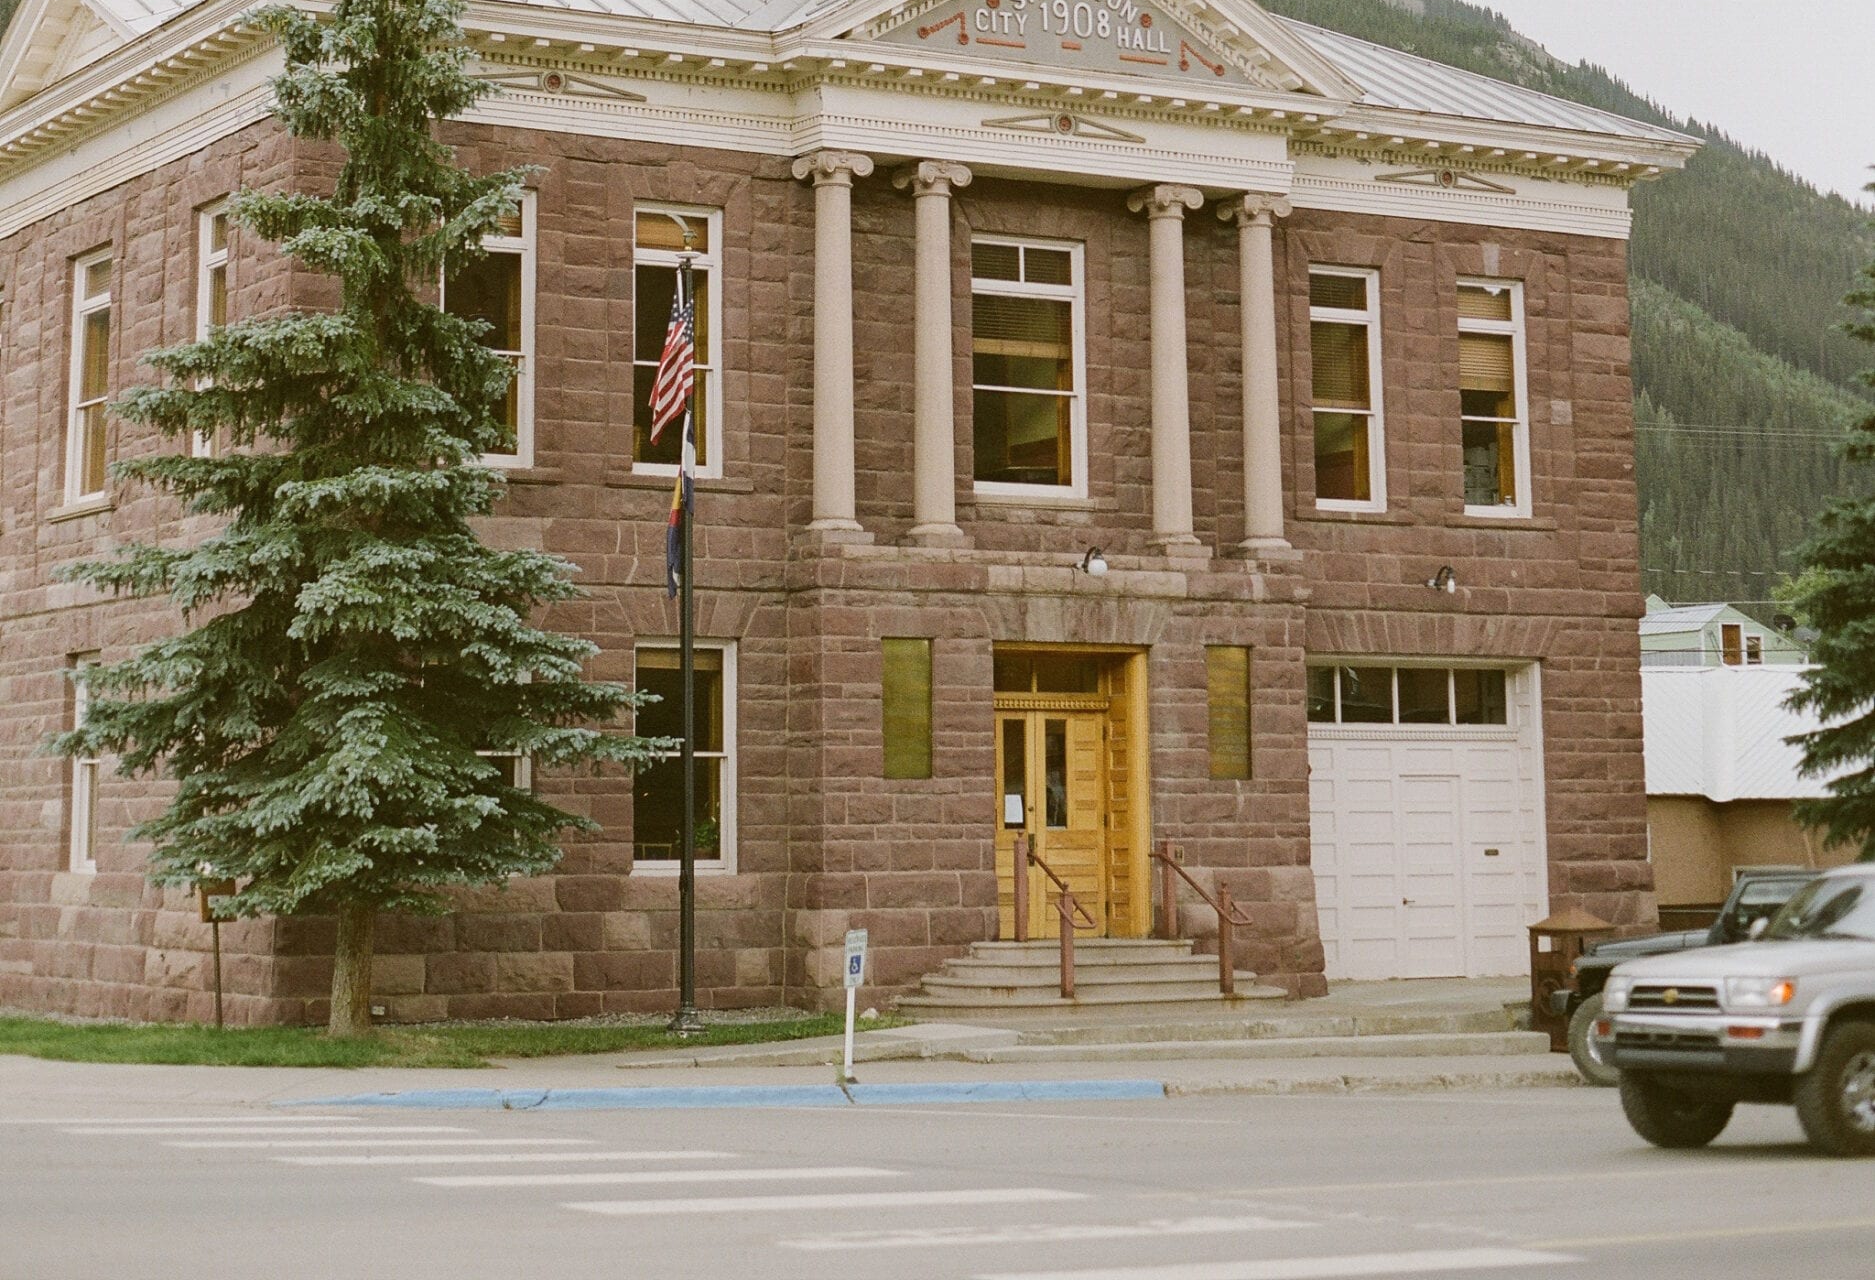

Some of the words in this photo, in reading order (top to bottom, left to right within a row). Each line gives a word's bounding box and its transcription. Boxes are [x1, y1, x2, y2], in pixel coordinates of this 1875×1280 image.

[976, 8, 1027, 35] CITY
[1039, 0, 1110, 38] 1908
[1117, 26, 1171, 53] HALL
